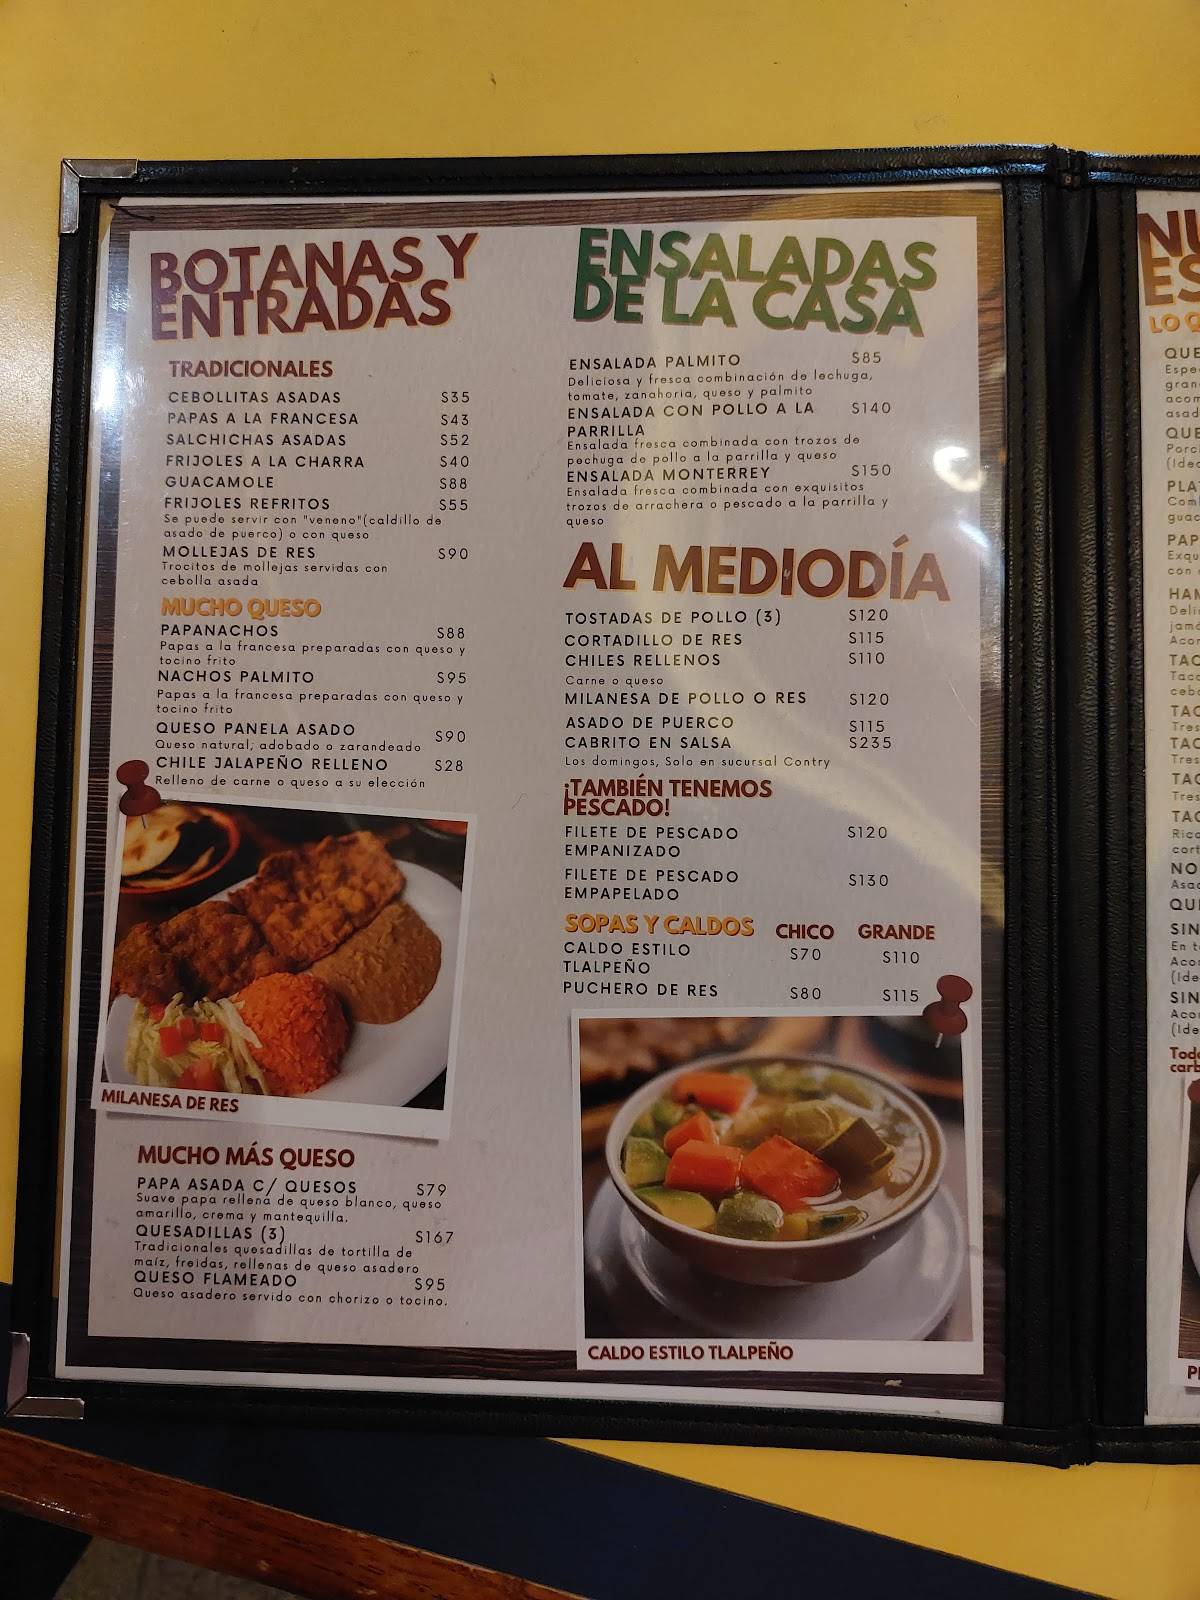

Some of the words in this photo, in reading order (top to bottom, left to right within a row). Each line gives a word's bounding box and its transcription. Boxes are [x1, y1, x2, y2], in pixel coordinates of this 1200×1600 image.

[150, 236, 425, 295] BOTANAS
[437, 232, 479, 280] Y
[578, 227, 938, 290] ENSALADAS
[151, 278, 453, 340] ENTRADAS
[573, 268, 645, 323] DE
[661, 277, 738, 328] LA
[752, 280, 925, 337] CASA
[1150, 313, 1181, 334] LO
[169, 359, 334, 378] TRADICIONALES
[569, 356, 657, 371] ENSALADA
[665, 354, 741, 368] PALMITO
[168, 391, 269, 404] CEBOLLITAS
[276, 391, 341, 404] ASADAS
[168, 412, 218, 424] PAPAS
[226, 412, 236, 424] A
[244, 412, 262, 424] LA
[270, 412, 359, 425] FRANCESA
[568, 406, 655, 420] ENSALADA
[663, 404, 703, 417] CON
[712, 402, 768, 416] POLLO
[776, 402, 787, 415] A
[795, 401, 814, 414] LA
[567, 424, 645, 438] PARRILLA
[166, 433, 274, 446] SALCHICHAS
[281, 434, 346, 447] ASADAS
[166, 454, 243, 467] FRIJOLES
[250, 455, 261, 468] A
[269, 455, 287, 468] LA
[295, 455, 365, 468] CHARRA
[165, 475, 274, 489] GUACAMOLE
[567, 469, 654, 483] ENSALADA
[662, 466, 770, 481] MONTERREY
[164, 497, 242, 510] FRIJOLES
[250, 497, 330, 510] REFRITOS
[163, 545, 249, 558] MOLLEJAS
[257, 546, 277, 559] DE
[286, 546, 316, 559] RES
[562, 541, 637, 592] AL
[652, 533, 951, 602] MEDIODÍA
[161, 596, 243, 617] MUCHO
[246, 597, 322, 621] QUESO
[565, 612, 653, 625] TOSTADAS
[661, 611, 682, 624] DE
[691, 610, 747, 624] POLLO
[161, 623, 278, 637] PAPANACHOS
[564, 634, 673, 647] CORTADILLO
[682, 633, 703, 646] DE
[711, 633, 742, 646] RES
[565, 654, 625, 667] CHILES
[633, 653, 721, 667] RELLENOS
[158, 669, 232, 683] NACHOS
[240, 670, 314, 684] PALMITO
[565, 692, 651, 705] MILANESA
[658, 692, 679, 705] DE
[688, 691, 745, 705] POLLO
[753, 691, 766, 704] O
[775, 691, 806, 704] RES
[156, 721, 216, 734] QUESO
[224, 722, 289, 735] PANELA
[296, 723, 355, 736] ASADO
[565, 716, 624, 729] ASADO
[632, 716, 653, 729] DE
[662, 716, 734, 729] PUERCO
[564, 736, 640, 749] CABRITO
[649, 736, 671, 749] EN
[680, 736, 732, 749] SALSA
[156, 756, 206, 769] CHILE
[214, 754, 303, 770] JALAPEÑO
[311, 757, 388, 771] RELLENO
[669, 779, 773, 798] TENEMOS
[565, 825, 618, 838] FILETE
[626, 826, 647, 839] DE
[656, 826, 738, 840] PESCADO
[565, 844, 681, 858] EMPANIZADO
[565, 868, 617, 881] FILETE
[626, 869, 647, 882] DE
[656, 869, 739, 883] PESCADO
[564, 886, 679, 901] EMPAPELADO
[564, 913, 639, 935] SOPAS
[643, 914, 660, 935] Y
[663, 915, 755, 937] CALDOS
[775, 923, 835, 940] CHICO
[857, 923, 935, 940] GRANDE
[564, 941, 623, 955] CALDO
[632, 942, 690, 957] ESTILO
[562, 958, 650, 975] TLALPEÑO
[563, 981, 648, 996] PUCHERO
[657, 983, 678, 996] DE
[687, 984, 718, 998] RES
[101, 1088, 183, 1109] MILANESA
[186, 1095, 207, 1110] DE
[209, 1097, 239, 1113] RES
[137, 1145, 220, 1166] MUCHO
[225, 1141, 274, 1167] MÁS
[279, 1147, 355, 1171] QUESO
[137, 1176, 180, 1190] PAPA
[187, 1177, 245, 1192] ASADA
[285, 1179, 357, 1194] QUESOS
[135, 1224, 252, 1240] QUESADILLAS
[134, 1270, 195, 1285] QUESO
[203, 1272, 297, 1287] FLAMEADO
[587, 1345, 645, 1361] CALDO
[649, 1345, 705, 1360] ESTILO
[708, 1341, 794, 1361] TLALPEÑO
